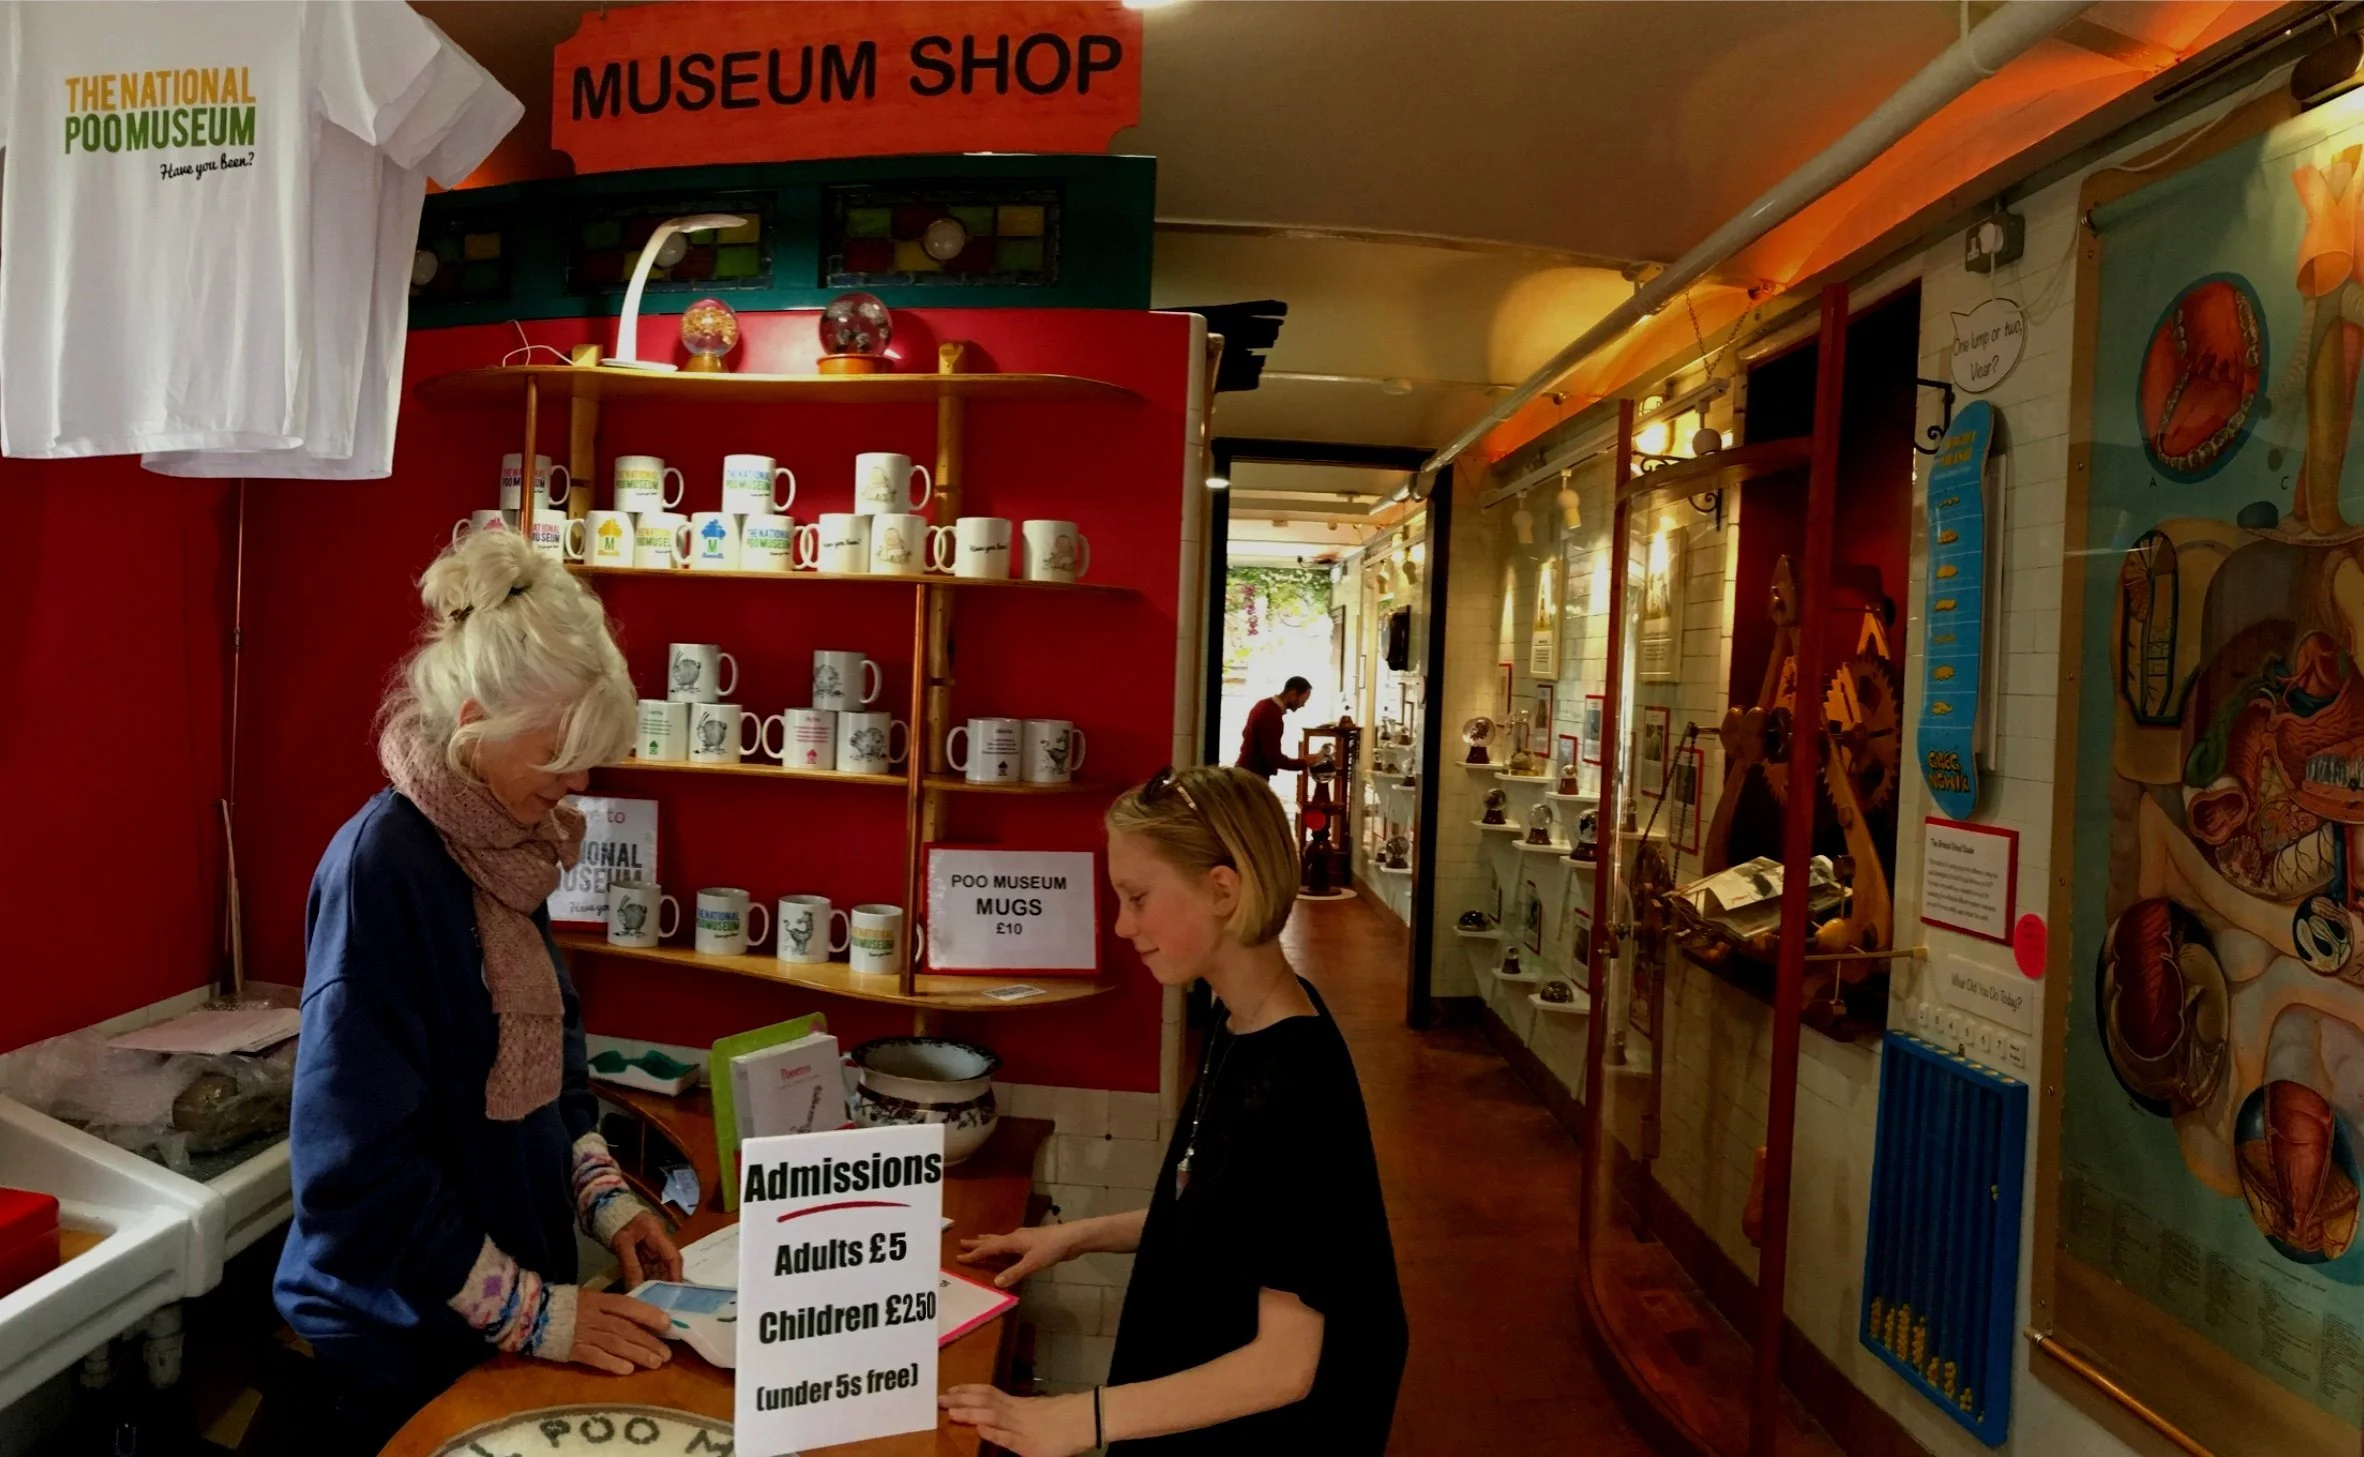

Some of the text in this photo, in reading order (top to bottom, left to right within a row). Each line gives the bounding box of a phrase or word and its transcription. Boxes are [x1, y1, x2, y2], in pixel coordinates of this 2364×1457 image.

[571, 33, 1123, 121] MUSEUM SHOP
[65, 67, 257, 113] THE NATIONAL
[65, 106, 257, 154] POO MUSEUM
[160, 162, 194, 181] Have
[195, 160, 219, 181] you
[1991, 327, 2001, 342] or
[2150, 476, 2157, 488] A
[2280, 476, 2289, 490] C
[604, 537, 615, 550] M
[607, 810, 626, 824] to
[951, 874, 1067, 890] POO MUSEUM
[975, 898, 1043, 917] MUGS
[996, 921, 1023, 936] £10
[1989, 985, 1999, 1002] Do
[743, 1152, 942, 1203] Admissions
[774, 1231, 908, 1277] Adults £5
[758, 1301, 878, 1345] Children
[757, 1362, 919, 1412] (under 5s free)
[539, 1415, 660, 1448] POO
